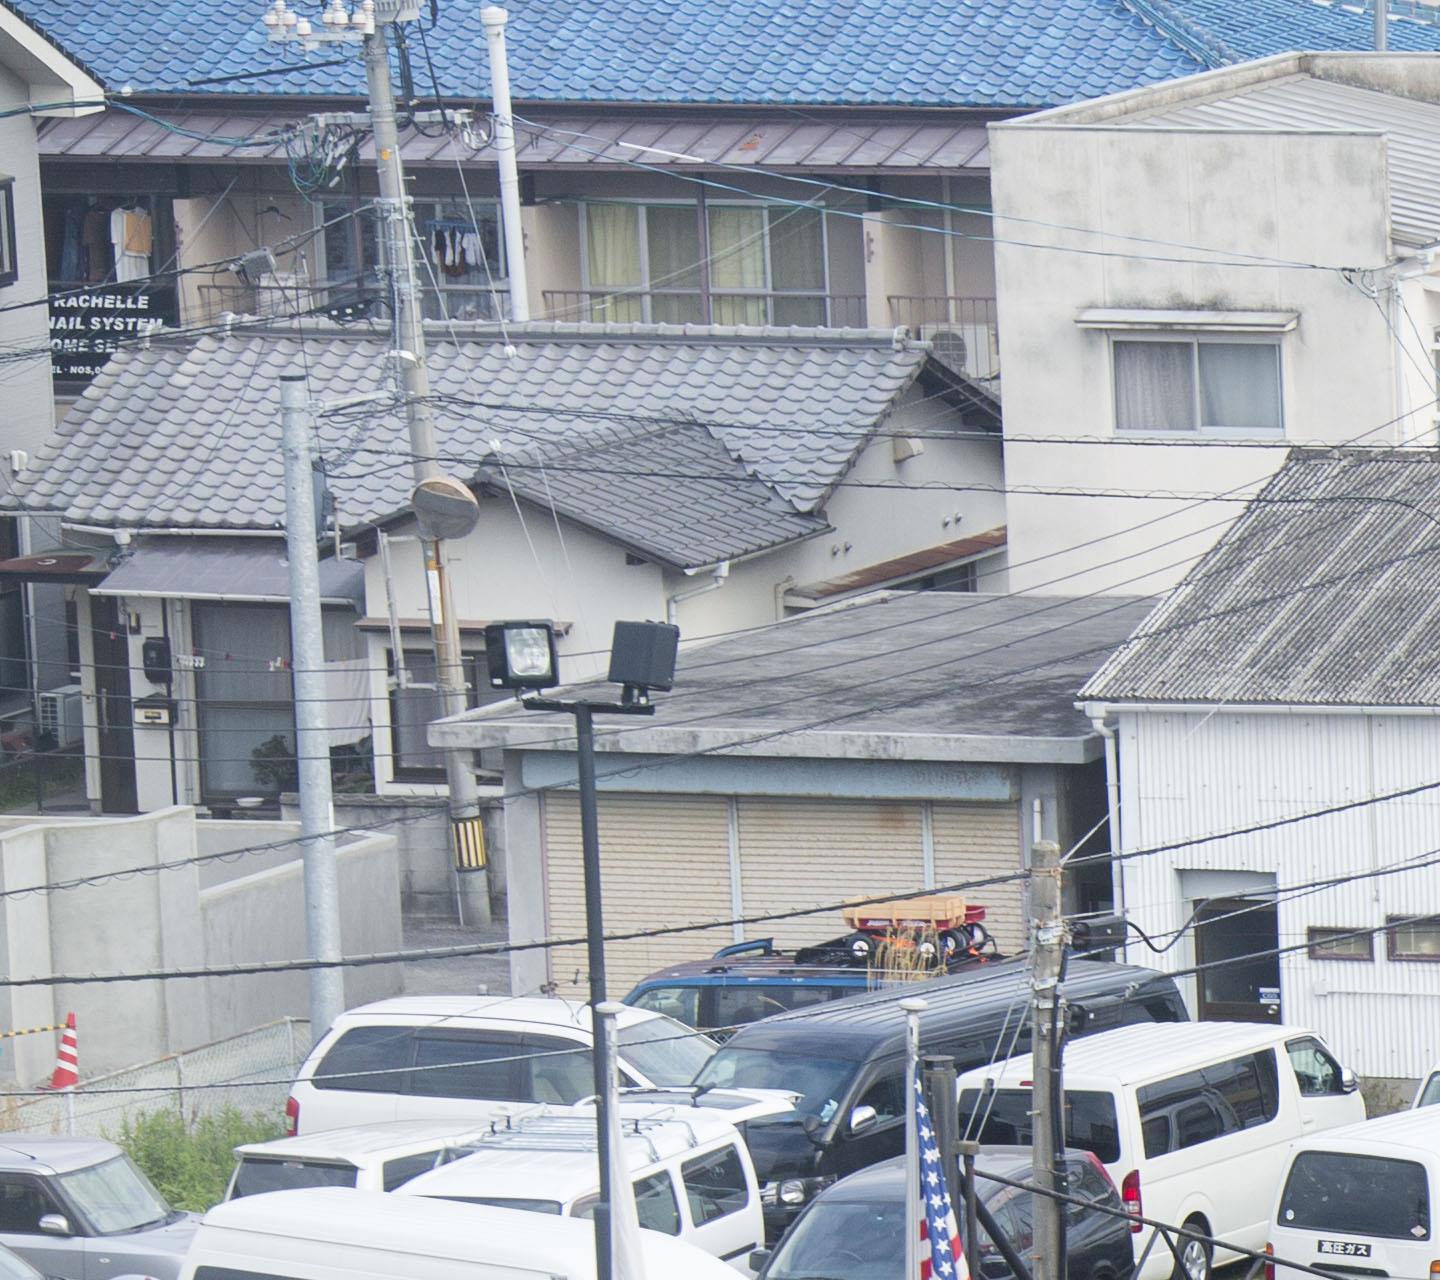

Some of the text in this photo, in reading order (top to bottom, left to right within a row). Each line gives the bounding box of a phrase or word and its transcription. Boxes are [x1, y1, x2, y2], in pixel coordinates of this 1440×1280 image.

[53, 294, 149, 309] RACHELLE
[1321, 1240, 1369, 1257] 高圧ガス
